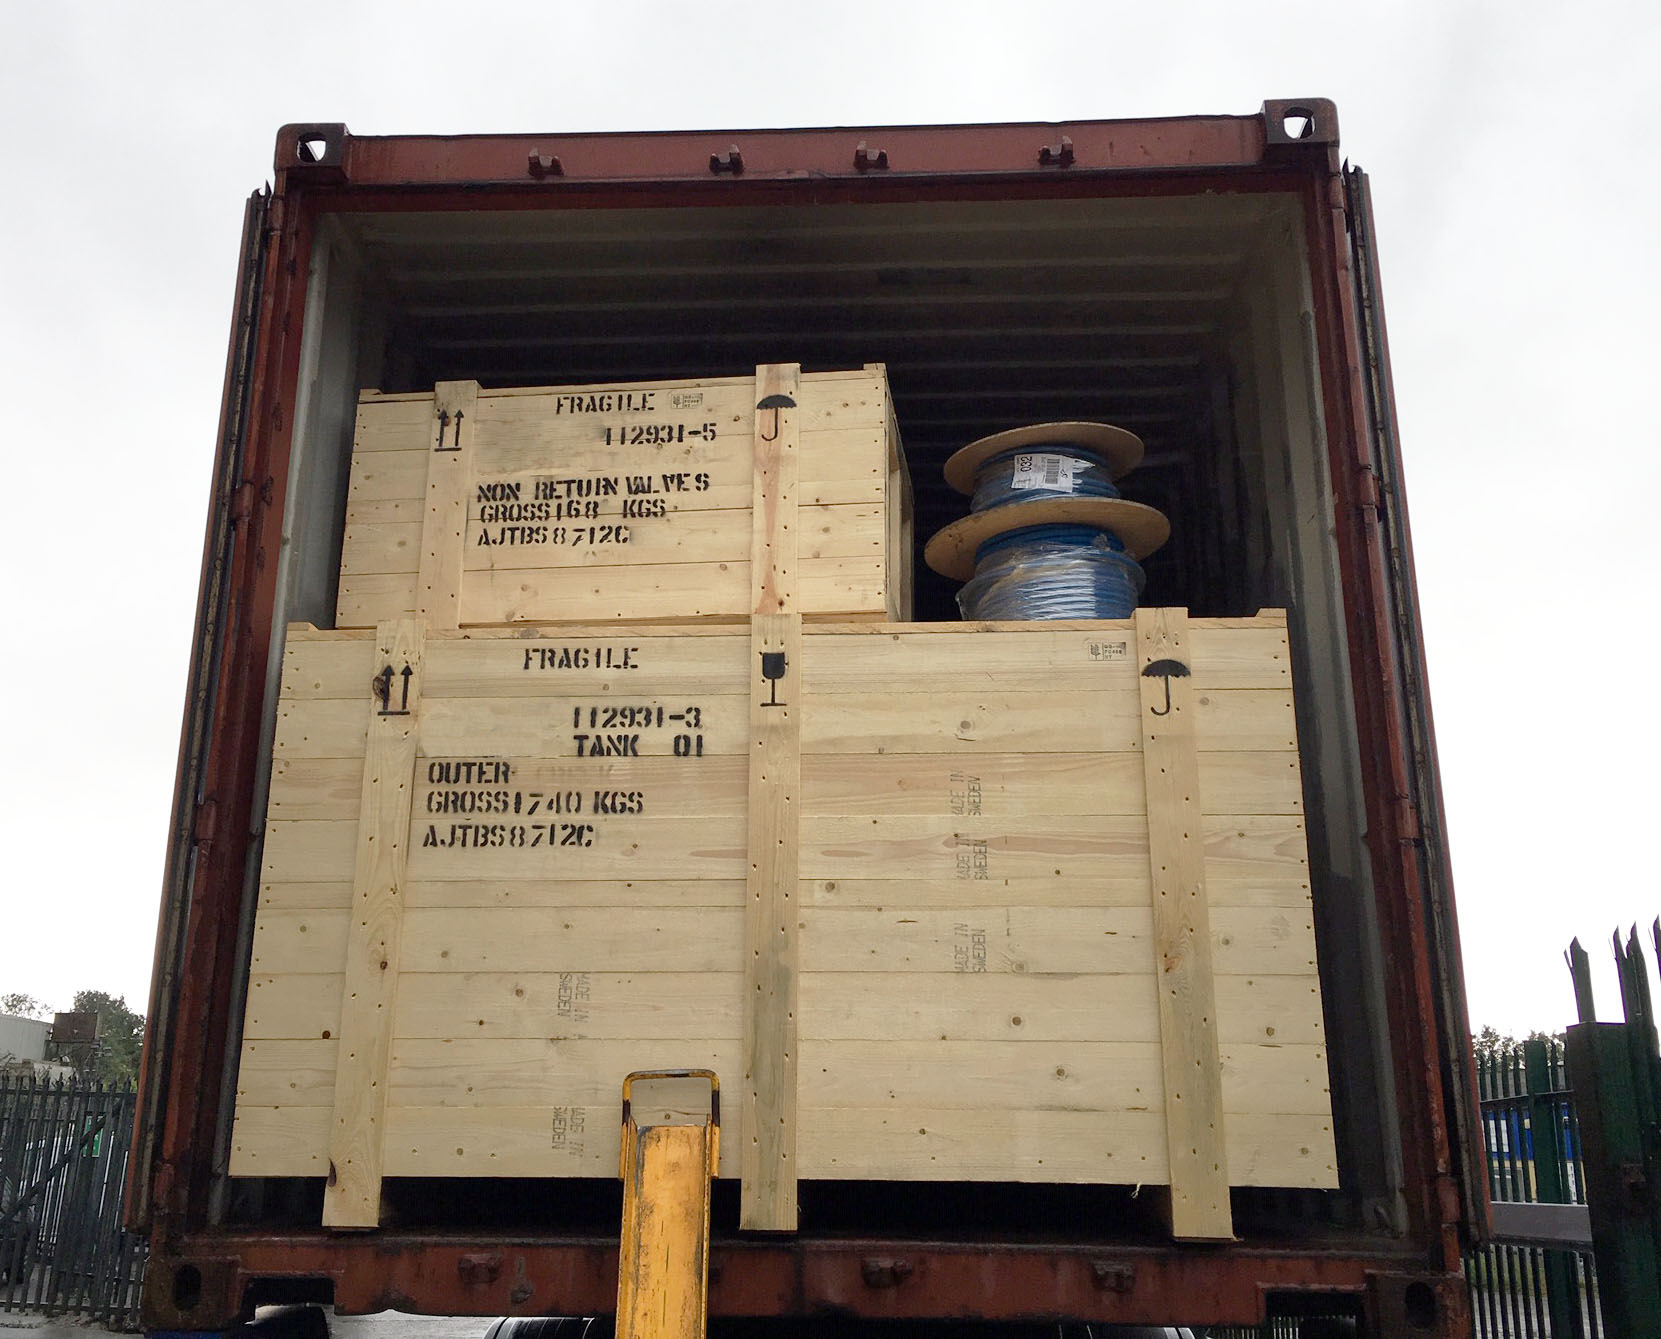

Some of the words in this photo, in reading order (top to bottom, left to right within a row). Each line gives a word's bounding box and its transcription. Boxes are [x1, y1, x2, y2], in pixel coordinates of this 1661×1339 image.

[556, 392, 655, 414] FRAGILE
[605, 423, 717, 446] 112931-5
[1020, 456, 1032, 472] 032
[477, 482, 521, 503] NON
[534, 477, 618, 501] RETURN
[625, 473, 710, 495] VALVES
[622, 498, 667, 519] KGS
[523, 647, 639, 670] FRAGILE
[573, 706, 702, 729] 112931-3
[573, 734, 640, 757] TANK
[428, 762, 511, 784] OUTER
[593, 791, 644, 814] KGS
